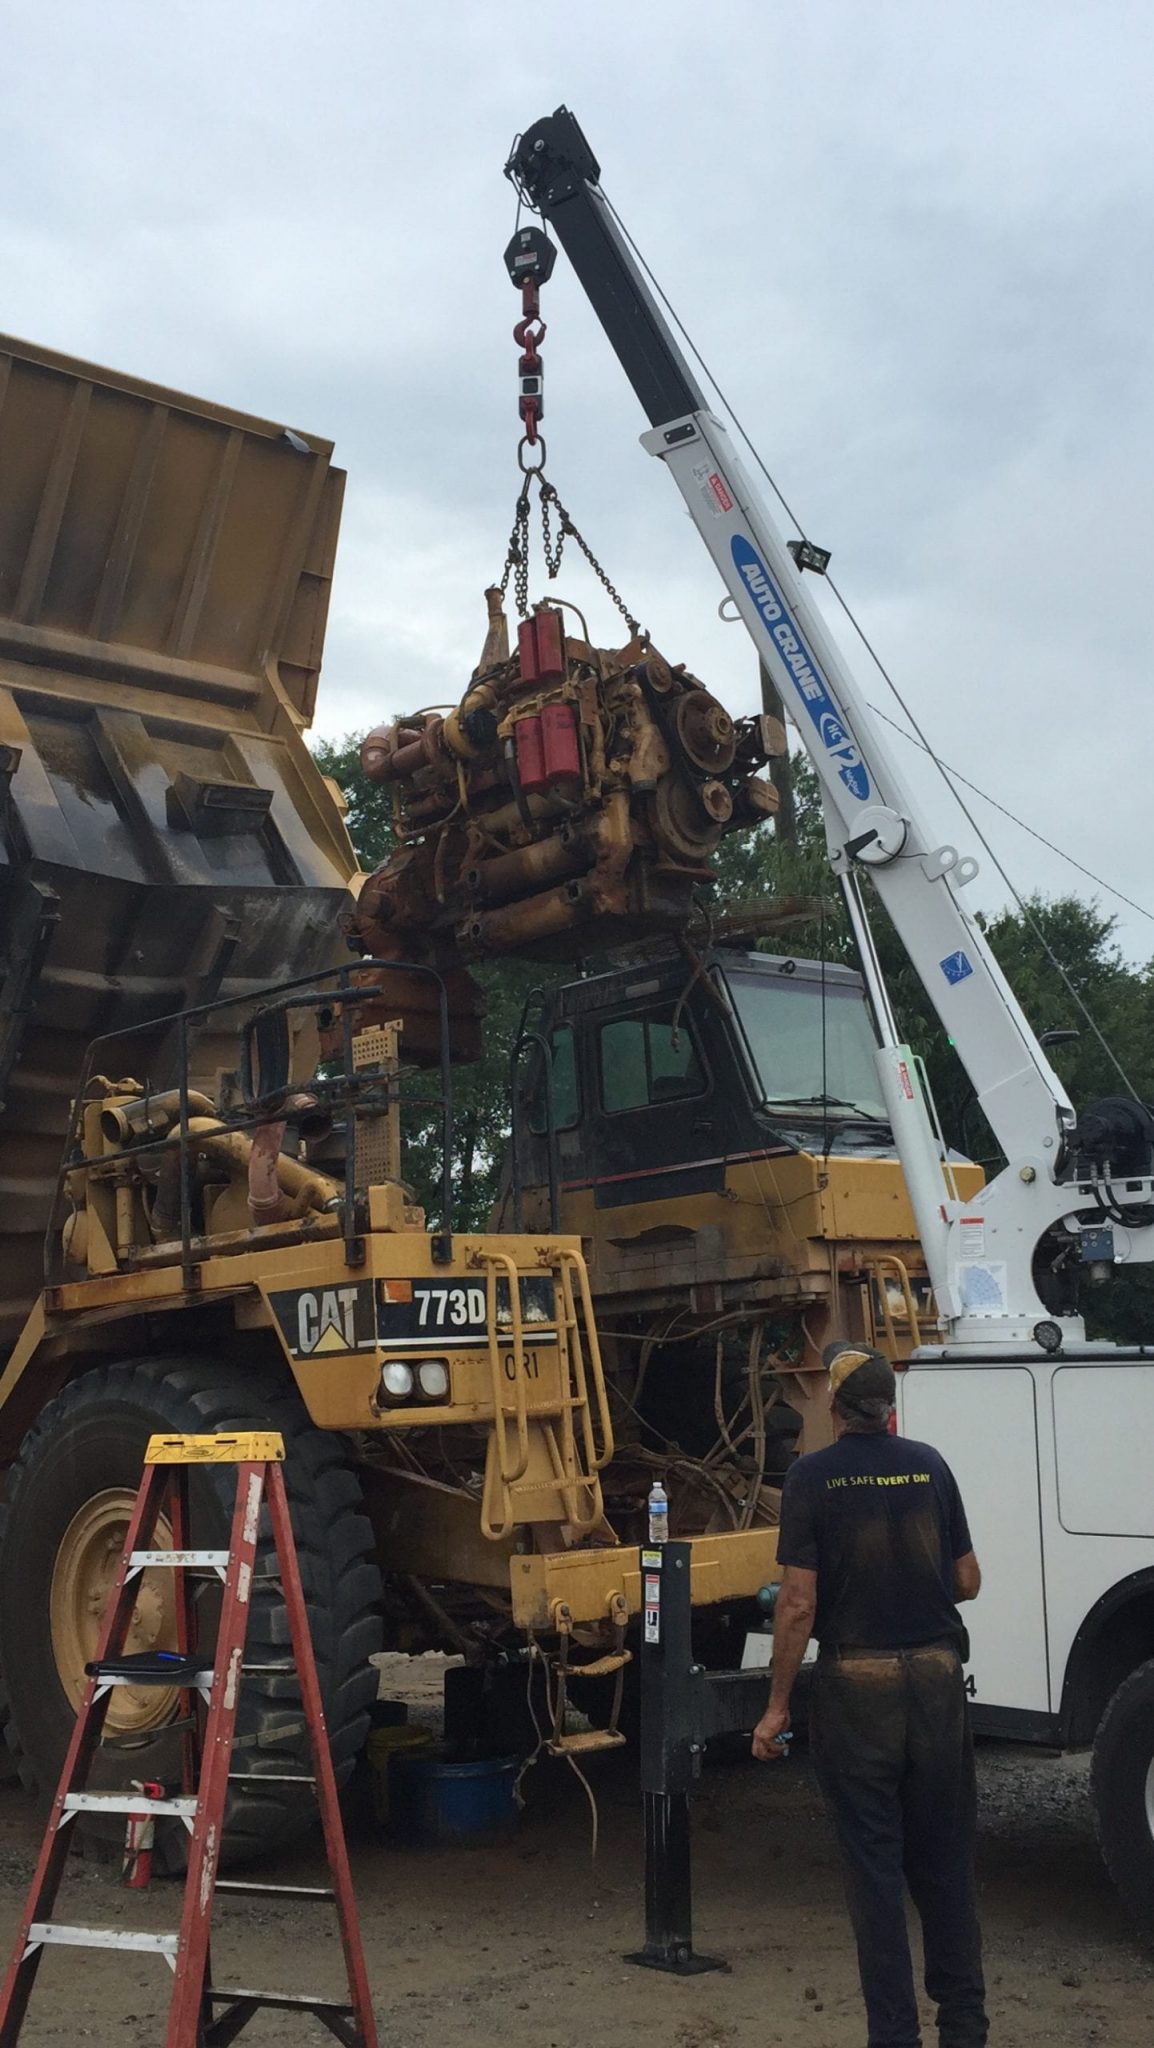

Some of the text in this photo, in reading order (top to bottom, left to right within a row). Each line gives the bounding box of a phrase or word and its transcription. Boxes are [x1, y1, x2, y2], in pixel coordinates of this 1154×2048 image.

[741, 563, 823, 701] AUTO CRANE
[827, 724, 842, 740] HC
[297, 1287, 359, 1354] CAT
[414, 1288, 487, 1326] 773D
[826, 1473, 931, 1489] LIVE SAFE EVERY DAY
